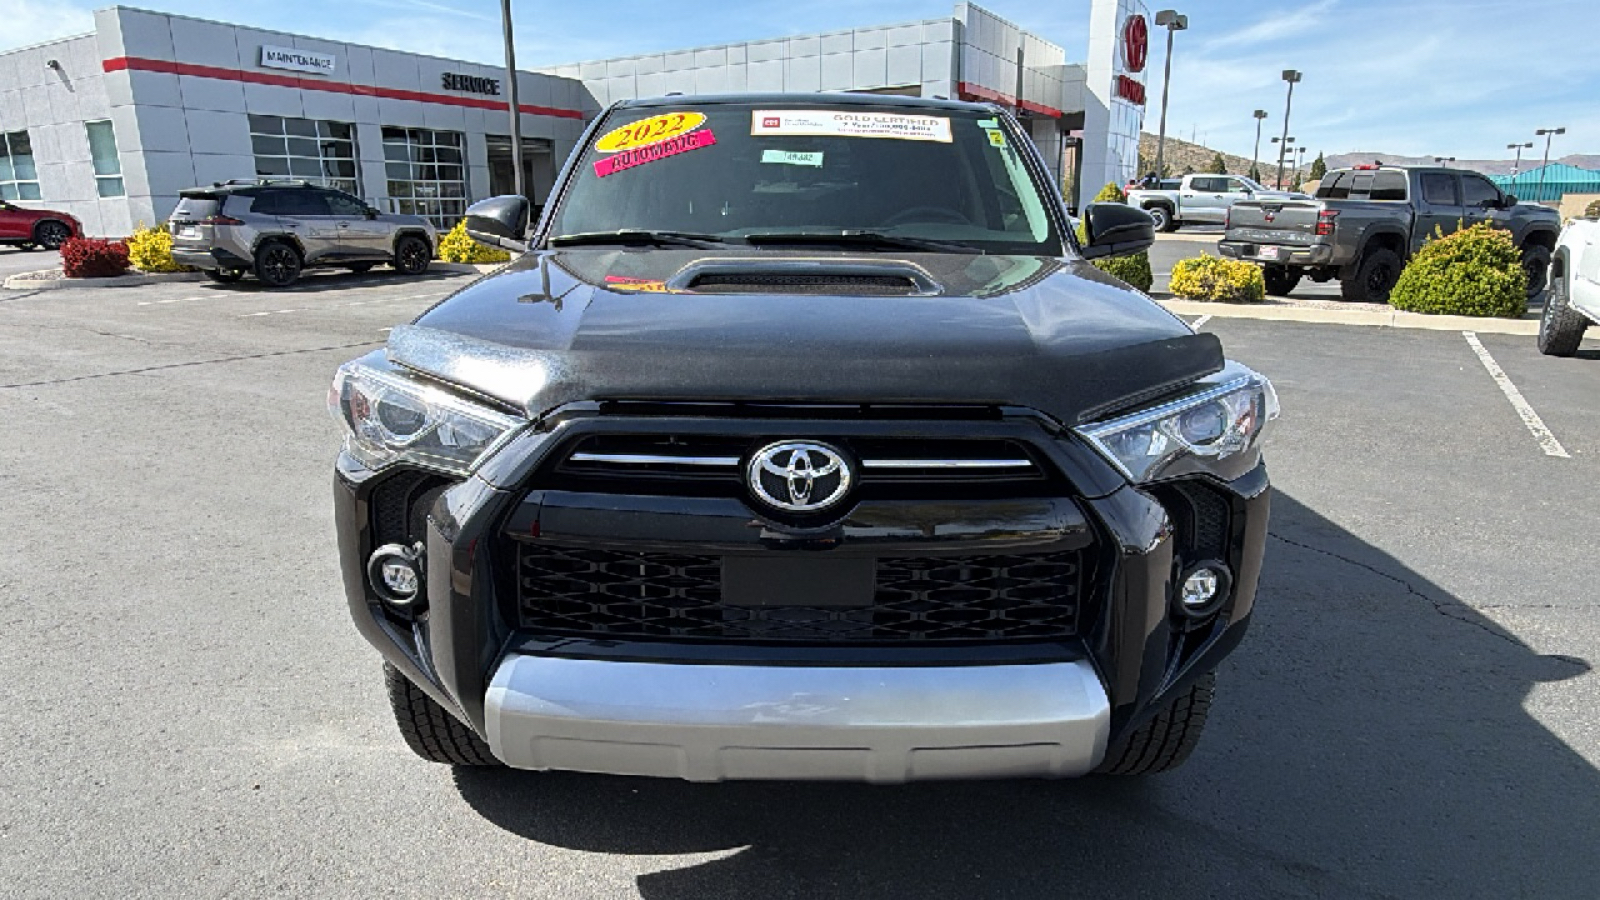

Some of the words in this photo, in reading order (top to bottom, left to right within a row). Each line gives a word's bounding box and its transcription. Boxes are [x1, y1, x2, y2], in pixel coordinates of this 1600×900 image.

[267, 51, 332, 69] MAINTENANCE
[442, 72, 500, 95] SERVICE
[615, 114, 685, 148] 2022
[834, 114, 871, 123] GOLD
[874, 117, 940, 127] CERTIFIED
[612, 134, 699, 169] AUTOMATIC
